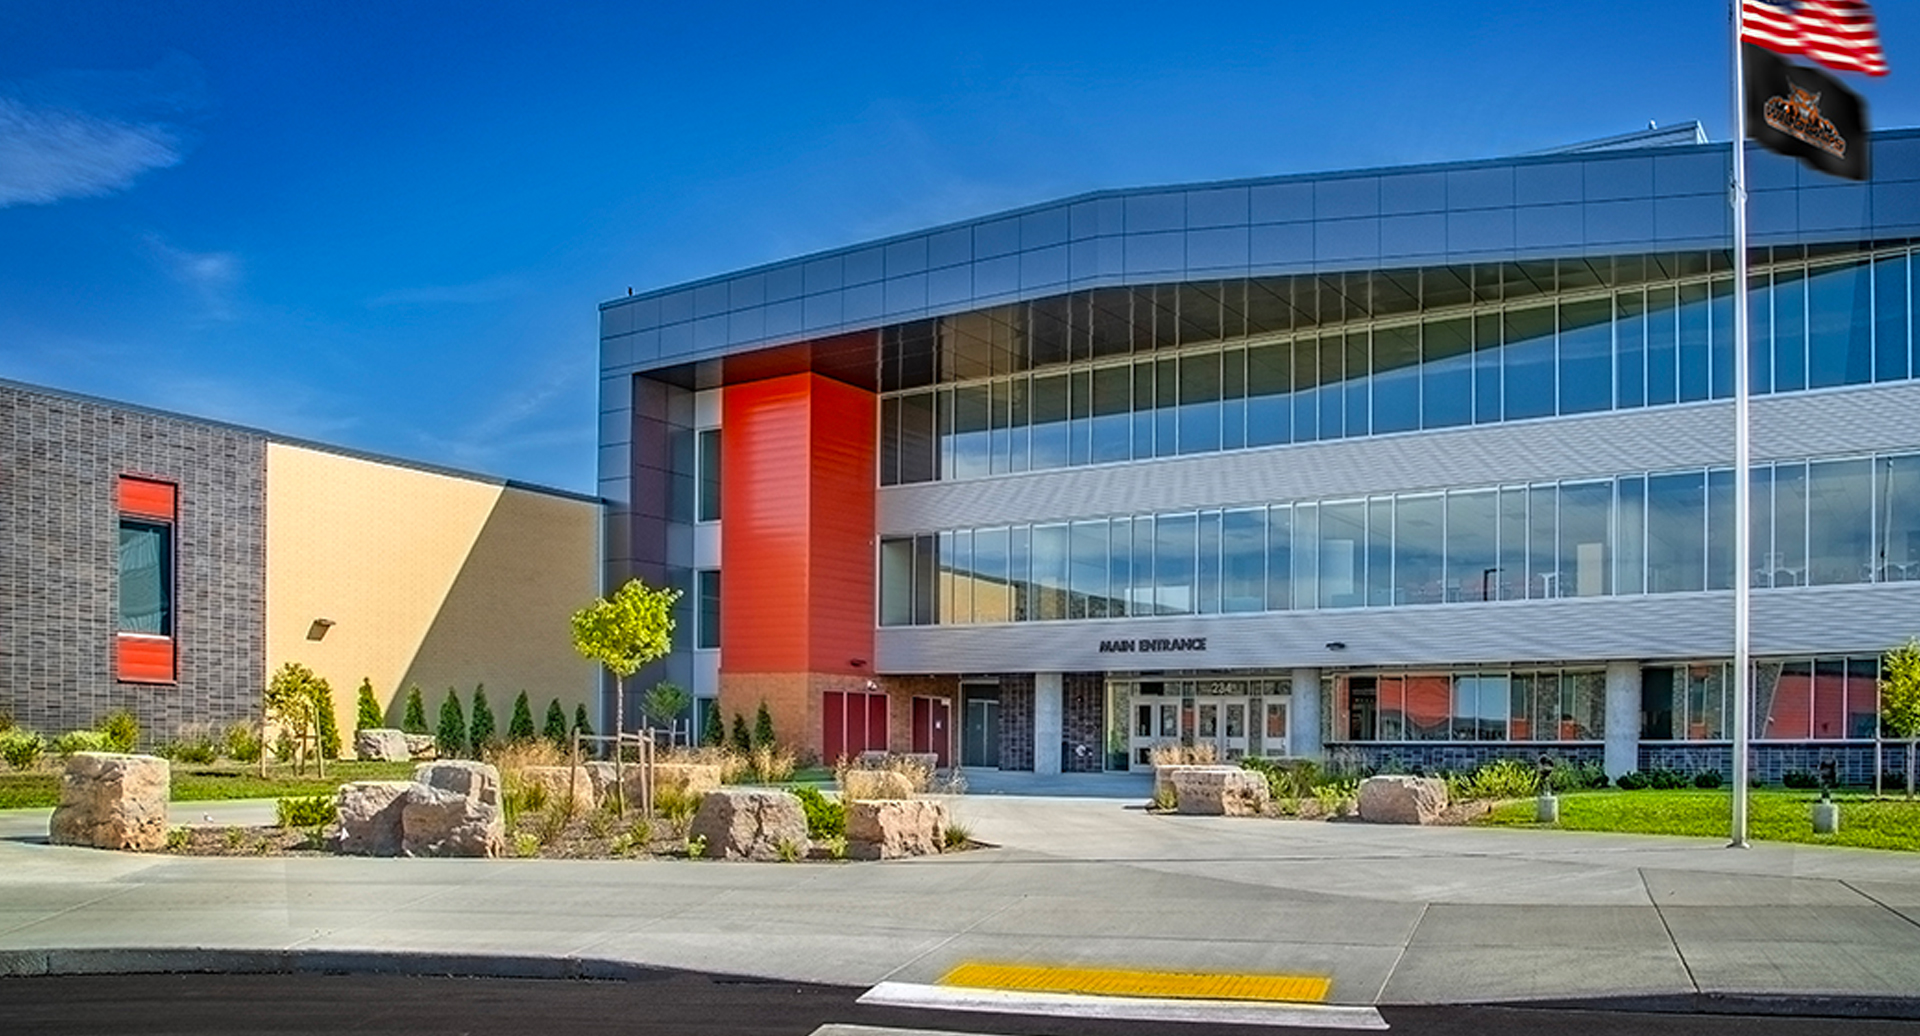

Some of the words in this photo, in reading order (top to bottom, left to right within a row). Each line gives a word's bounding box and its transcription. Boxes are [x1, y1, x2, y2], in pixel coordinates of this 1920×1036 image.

[1099, 640, 1135, 653] MAIN
[1138, 638, 1207, 652] ENTRANCE
[1211, 681, 1232, 694] 234
